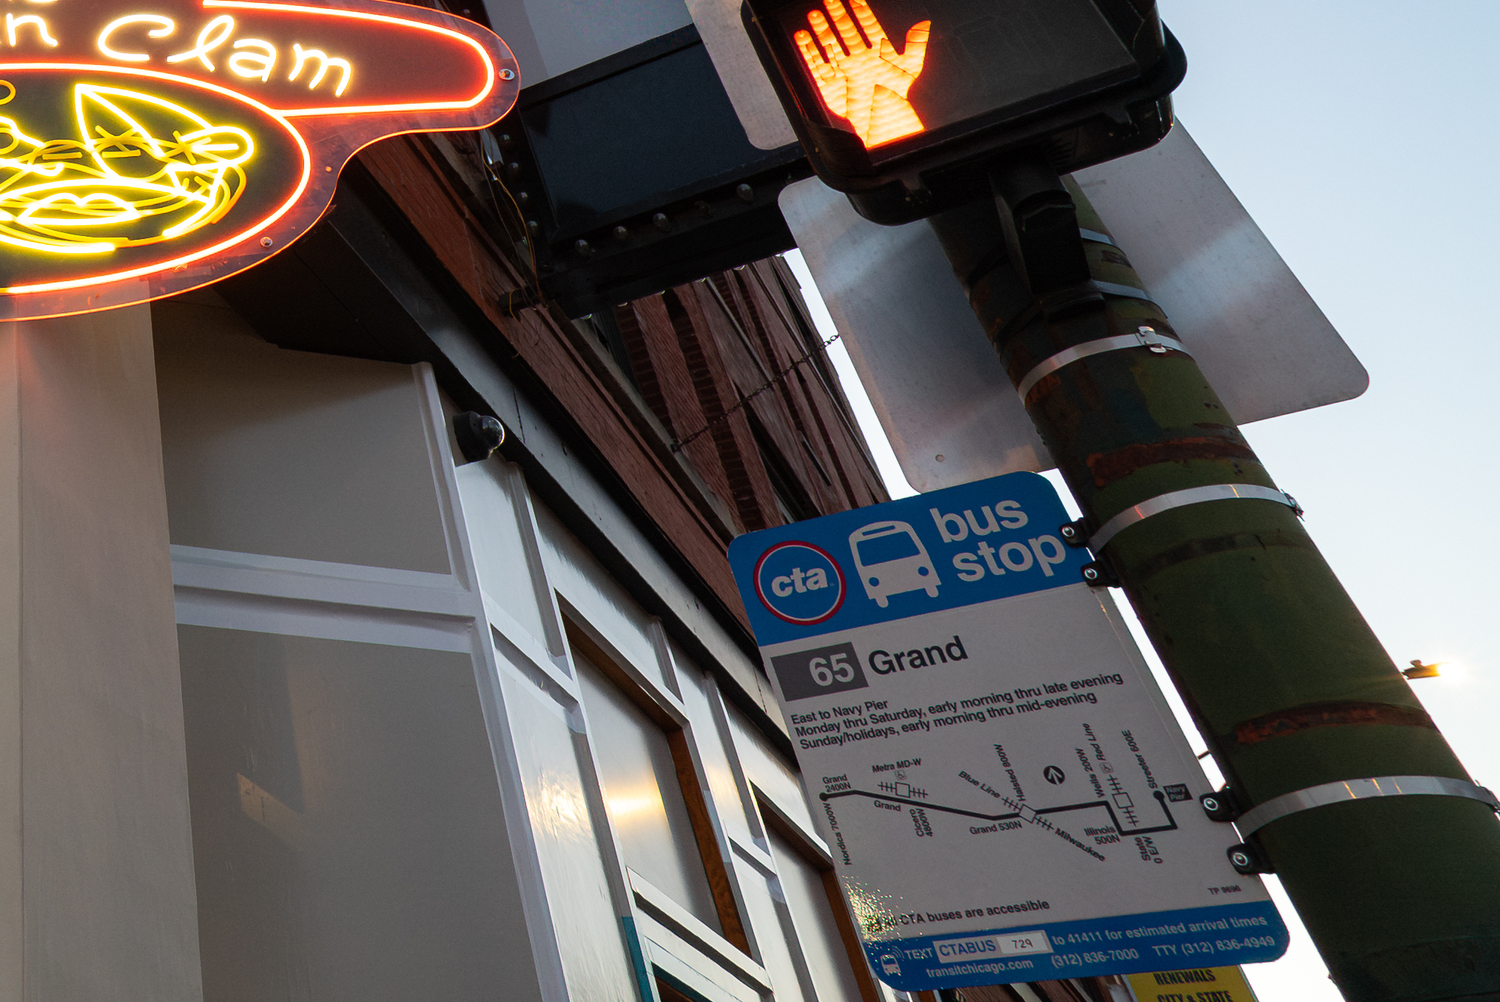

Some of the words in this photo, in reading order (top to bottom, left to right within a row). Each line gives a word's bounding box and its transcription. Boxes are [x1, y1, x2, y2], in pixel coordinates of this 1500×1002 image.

[97, 12, 354, 98] Clam
[930, 500, 1029, 543] bus
[952, 533, 1066, 582] stop
[771, 567, 829, 597] cta
[809, 652, 855, 687] 65
[868, 635, 969, 675] Grand
[791, 711, 816, 725] East
[819, 710, 831, 720] to
[832, 705, 862, 717] Navy
[864, 700, 888, 712] Pier
[794, 721, 841, 737] Monday
[843, 716, 868, 729] thru
[869, 706, 927, 725] Saturday,
[928, 700, 957, 715] early
[960, 691, 1014, 709] morning
[1014, 686, 1042, 700] thru
[1042, 682, 1068, 695] late
[1070, 673, 1124, 690] evening
[799, 726, 900, 750] Sunday/holidays,
[901, 719, 930, 733] early
[933, 709, 986, 728] morning
[986, 704, 1015, 718] thru
[1016, 691, 1098, 713] mid-evening
[1082, 723, 1097, 742] Line
[1090, 742, 1106, 761] Red
[1121, 729, 1140, 753] 600E
[872, 763, 895, 774] Metra
[896, 758, 922, 769] MD-W
[1074, 748, 1094, 772] 200W
[1135, 753, 1158, 789] Streeter
[822, 773, 848, 785] Grand
[825, 782, 852, 793] 2400N
[958, 770, 980, 787] Blue
[980, 783, 1001, 799] Line
[1004, 768, 1026, 802] Halsted
[1089, 773, 1106, 798] Wells
[822, 802, 840, 831] 7000W
[873, 800, 901, 812] Grand
[909, 808, 925, 837] Cicero
[915, 807, 933, 837] 4800W
[969, 822, 998, 835] Grand
[998, 820, 1023, 832] 530N
[1083, 826, 1116, 837] Illinois
[835, 832, 853, 866] Nordica
[1055, 827, 1106, 862] Milwaukee
[1094, 834, 1121, 845] 500N
[1134, 836, 1151, 862] State
[900, 912, 926, 926] CTA
[926, 910, 963, 923] buses
[965, 909, 984, 919] are
[988, 899, 1050, 916] accessible
[904, 947, 934, 961] TEXT
[938, 940, 997, 957] CTABUS
[1012, 938, 1034, 949] 729
[1052, 935, 1066, 946] to
[1067, 930, 1104, 945] 41411
[1105, 929, 1125, 941] for
[1126, 922, 1187, 939] estimated
[1188, 917, 1229, 933] arrival
[1230, 915, 1268, 929] times
[926, 958, 1034, 978] transitchicago.com
[1051, 953, 1083, 969] (312)
[1084, 947, 1140, 964] 836-7000
[1151, 944, 1178, 958] TTY
[1181, 941, 1214, 956] (312)
[1215, 935, 1276, 951] 836-4949
[1152, 968, 1217, 985] RENEWALS
